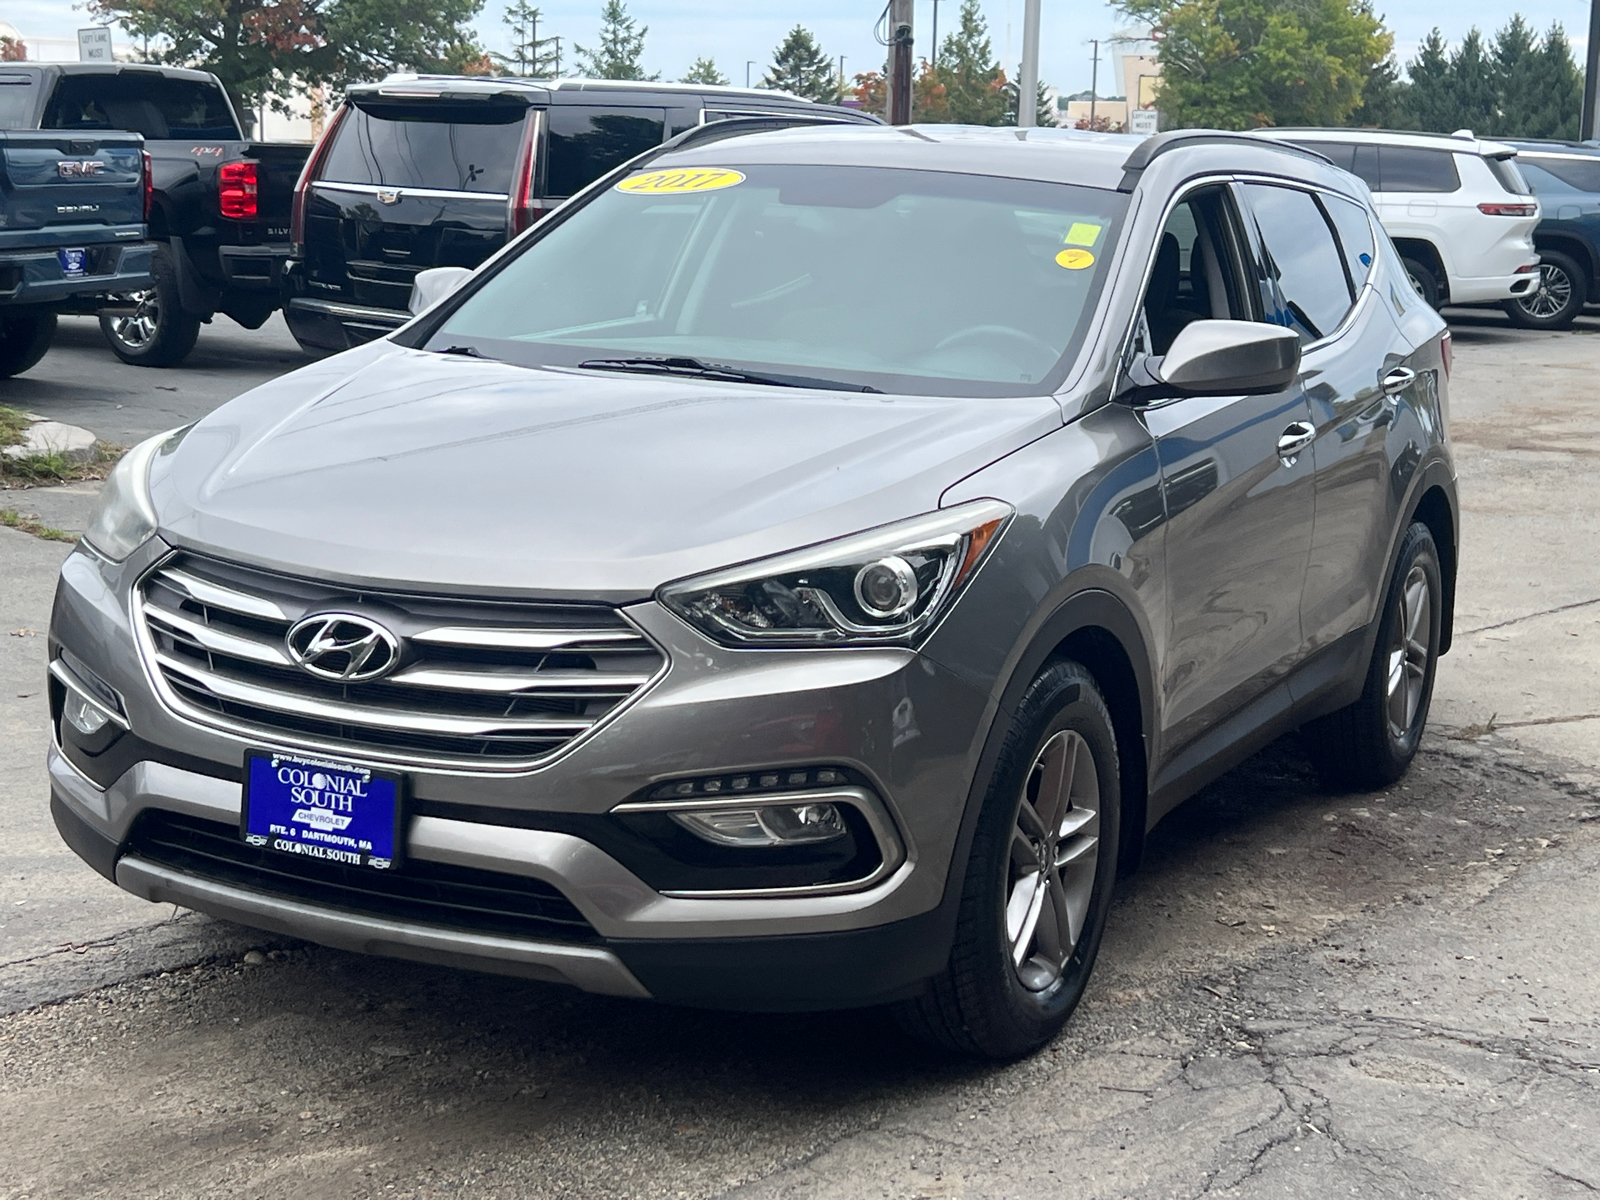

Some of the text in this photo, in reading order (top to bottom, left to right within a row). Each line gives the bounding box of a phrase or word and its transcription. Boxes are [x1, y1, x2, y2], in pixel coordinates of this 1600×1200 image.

[88, 48, 103, 58] MUST
[58, 161, 104, 177] GMC
[629, 173, 728, 189] 2017
[57, 205, 99, 213] DENALI
[277, 767, 367, 797] COLONIAL
[291, 787, 353, 812] SOUTH
[298, 811, 346, 827] CHEVROLET
[290, 828, 296, 836] 6
[359, 840, 372, 850] MA
[274, 839, 361, 865] COLONIAL SOUTH
